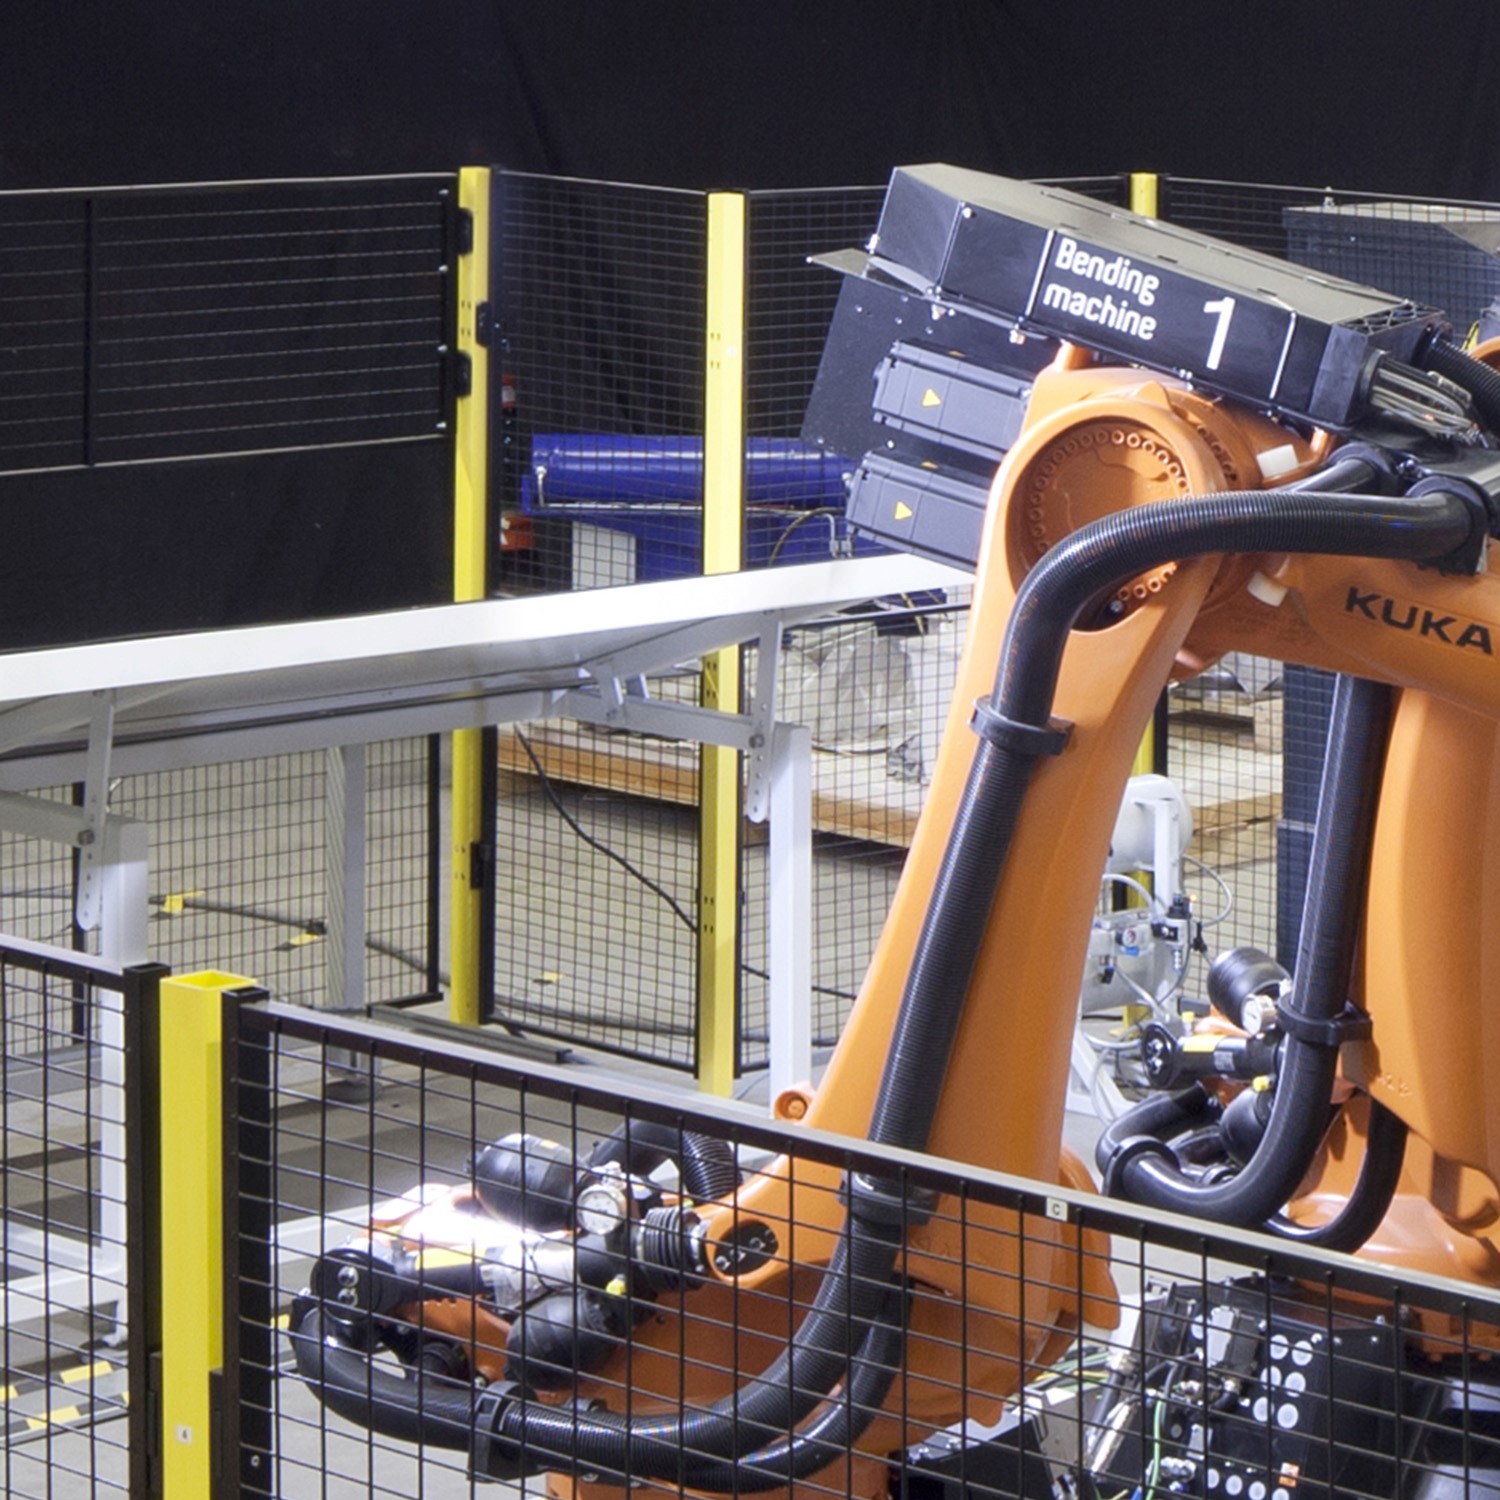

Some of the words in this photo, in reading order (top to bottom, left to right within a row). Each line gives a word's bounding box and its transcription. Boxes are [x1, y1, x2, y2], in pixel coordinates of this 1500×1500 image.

[1054, 237, 1160, 306] Bending
[1042, 283, 1157, 340] machine
[1203, 296, 1236, 371] 1
[1345, 586, 1493, 656] KUKA
[1052, 1203, 1060, 1216] C
